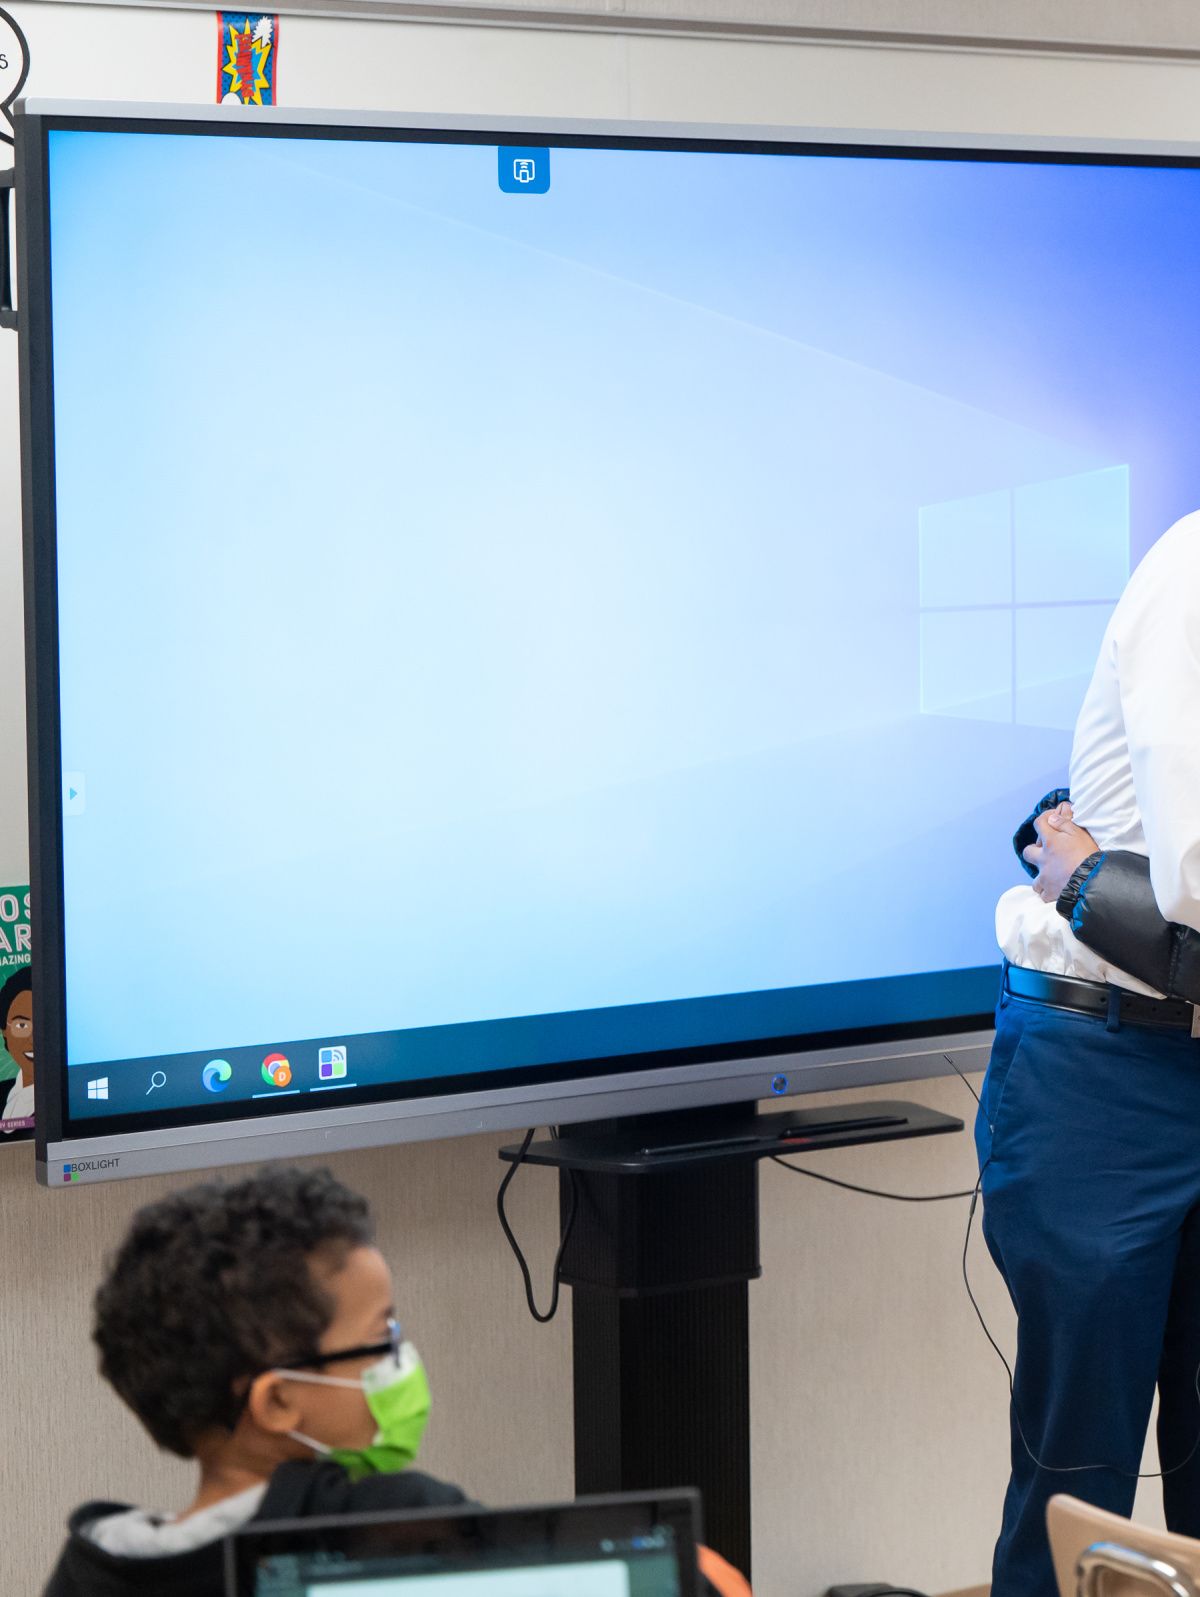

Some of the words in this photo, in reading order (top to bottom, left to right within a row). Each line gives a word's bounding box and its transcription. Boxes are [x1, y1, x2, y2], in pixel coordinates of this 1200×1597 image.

[0, 953, 31, 966] AZING
[278, 1071, 287, 1082] D
[7, 1120, 26, 1128] SERIES
[71, 1158, 121, 1173] BOXLIGHT
